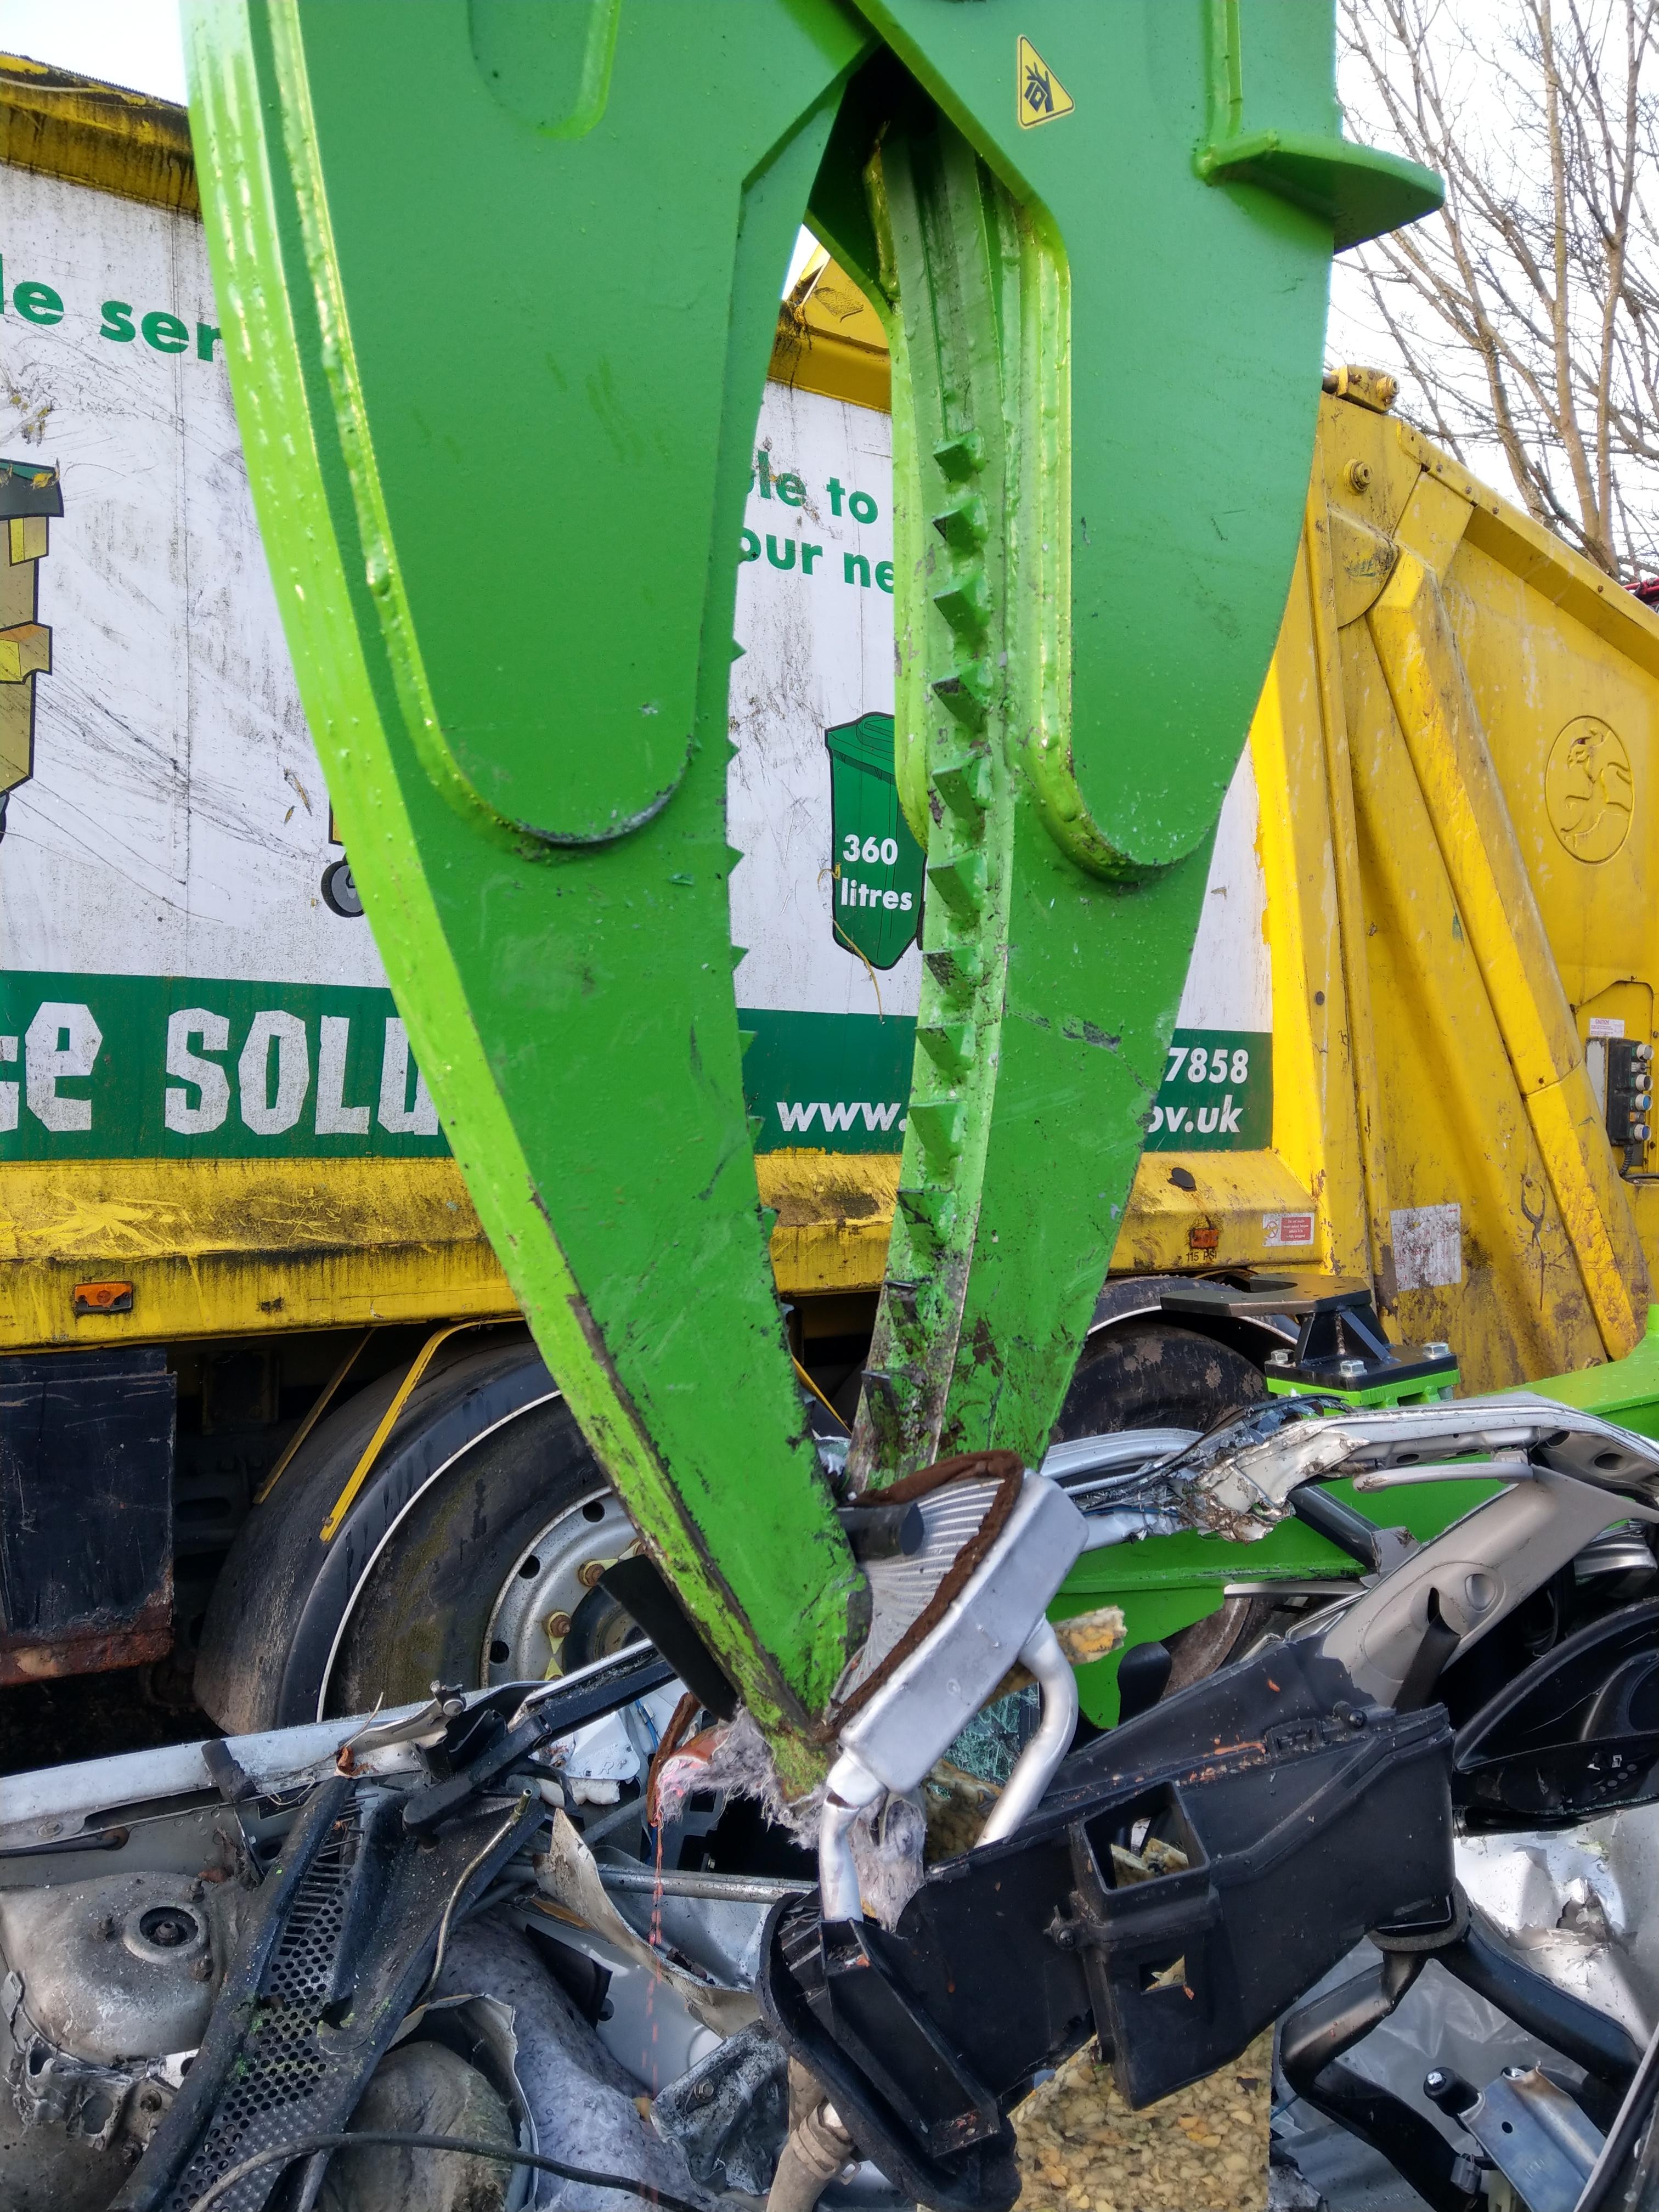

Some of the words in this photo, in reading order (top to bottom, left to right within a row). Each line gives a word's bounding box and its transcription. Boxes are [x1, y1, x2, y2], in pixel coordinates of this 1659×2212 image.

[0, 253, 64, 325] e
[747, 450, 808, 507] le
[826, 476, 878, 524] to
[843, 834, 898, 865] 360
[841, 878, 913, 911] litres
[1165, 1047, 1249, 1084] 7858
[1186, 1251, 1199, 1261] 115
[1203, 1250, 1217, 1261] PSI
